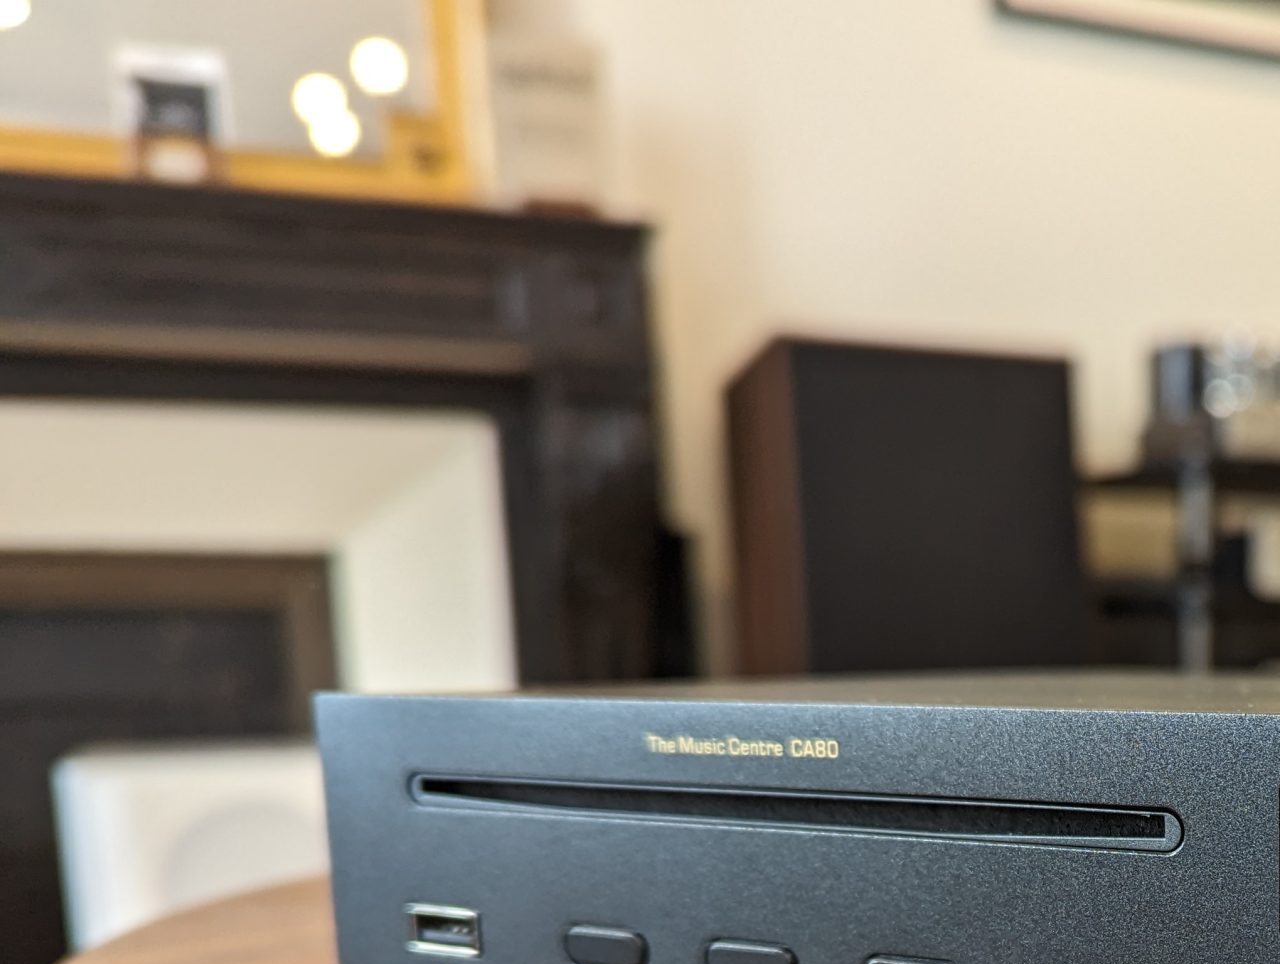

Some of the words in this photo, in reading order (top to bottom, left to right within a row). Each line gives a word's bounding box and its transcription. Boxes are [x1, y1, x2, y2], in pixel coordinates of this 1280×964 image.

[647, 736, 675, 753] The
[679, 737, 725, 756] Music
[729, 738, 783, 756] Centre
